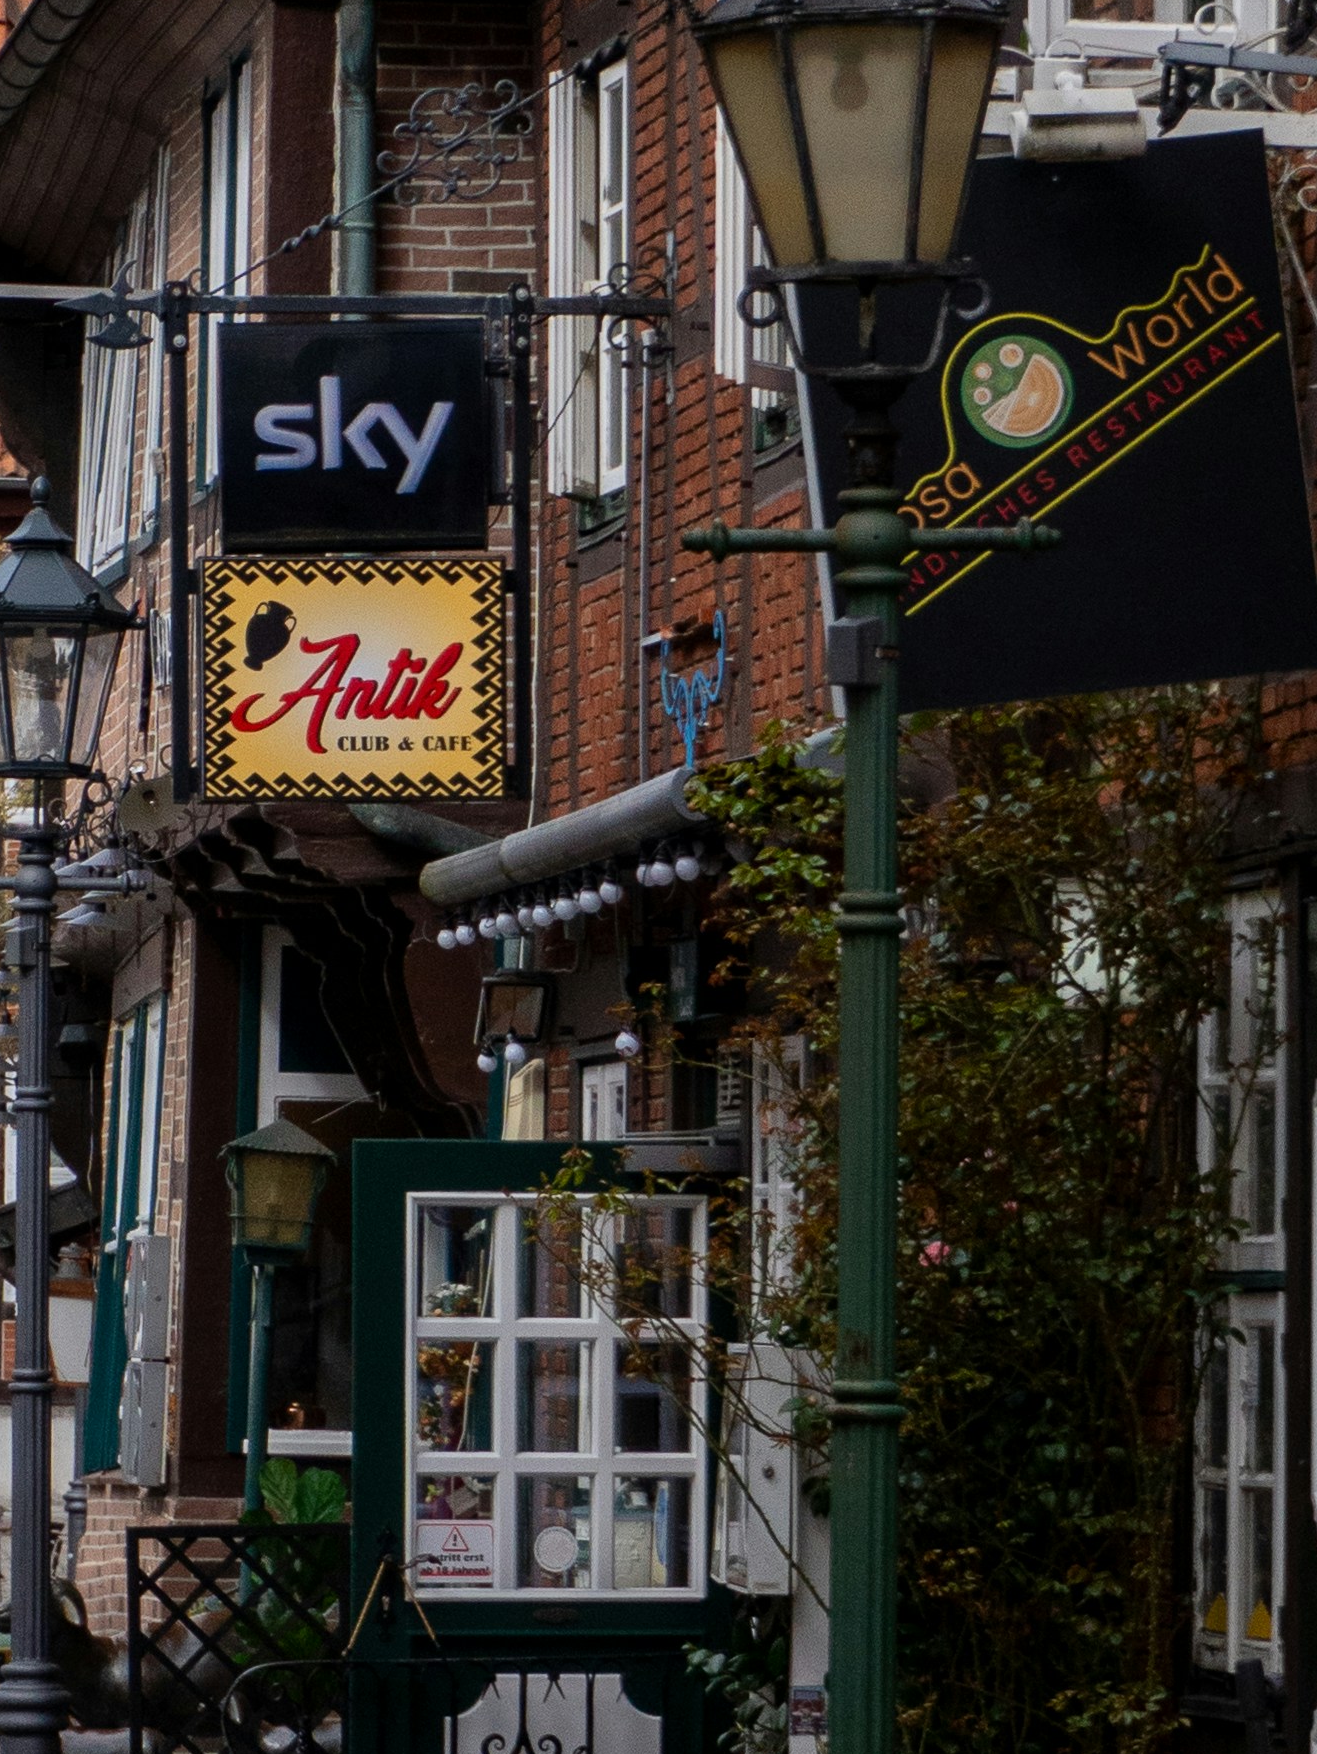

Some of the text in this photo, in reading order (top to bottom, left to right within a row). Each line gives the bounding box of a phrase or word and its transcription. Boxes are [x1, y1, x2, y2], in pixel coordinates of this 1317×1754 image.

[1087, 253, 1245, 380] World
[254, 376, 455, 495] sky
[1067, 310, 1265, 469] RESTAURANT
[230, 633, 464, 754] Antik
[337, 735, 472, 752] CLUB & CAFE
[463, 1553, 484, 1562] erst
